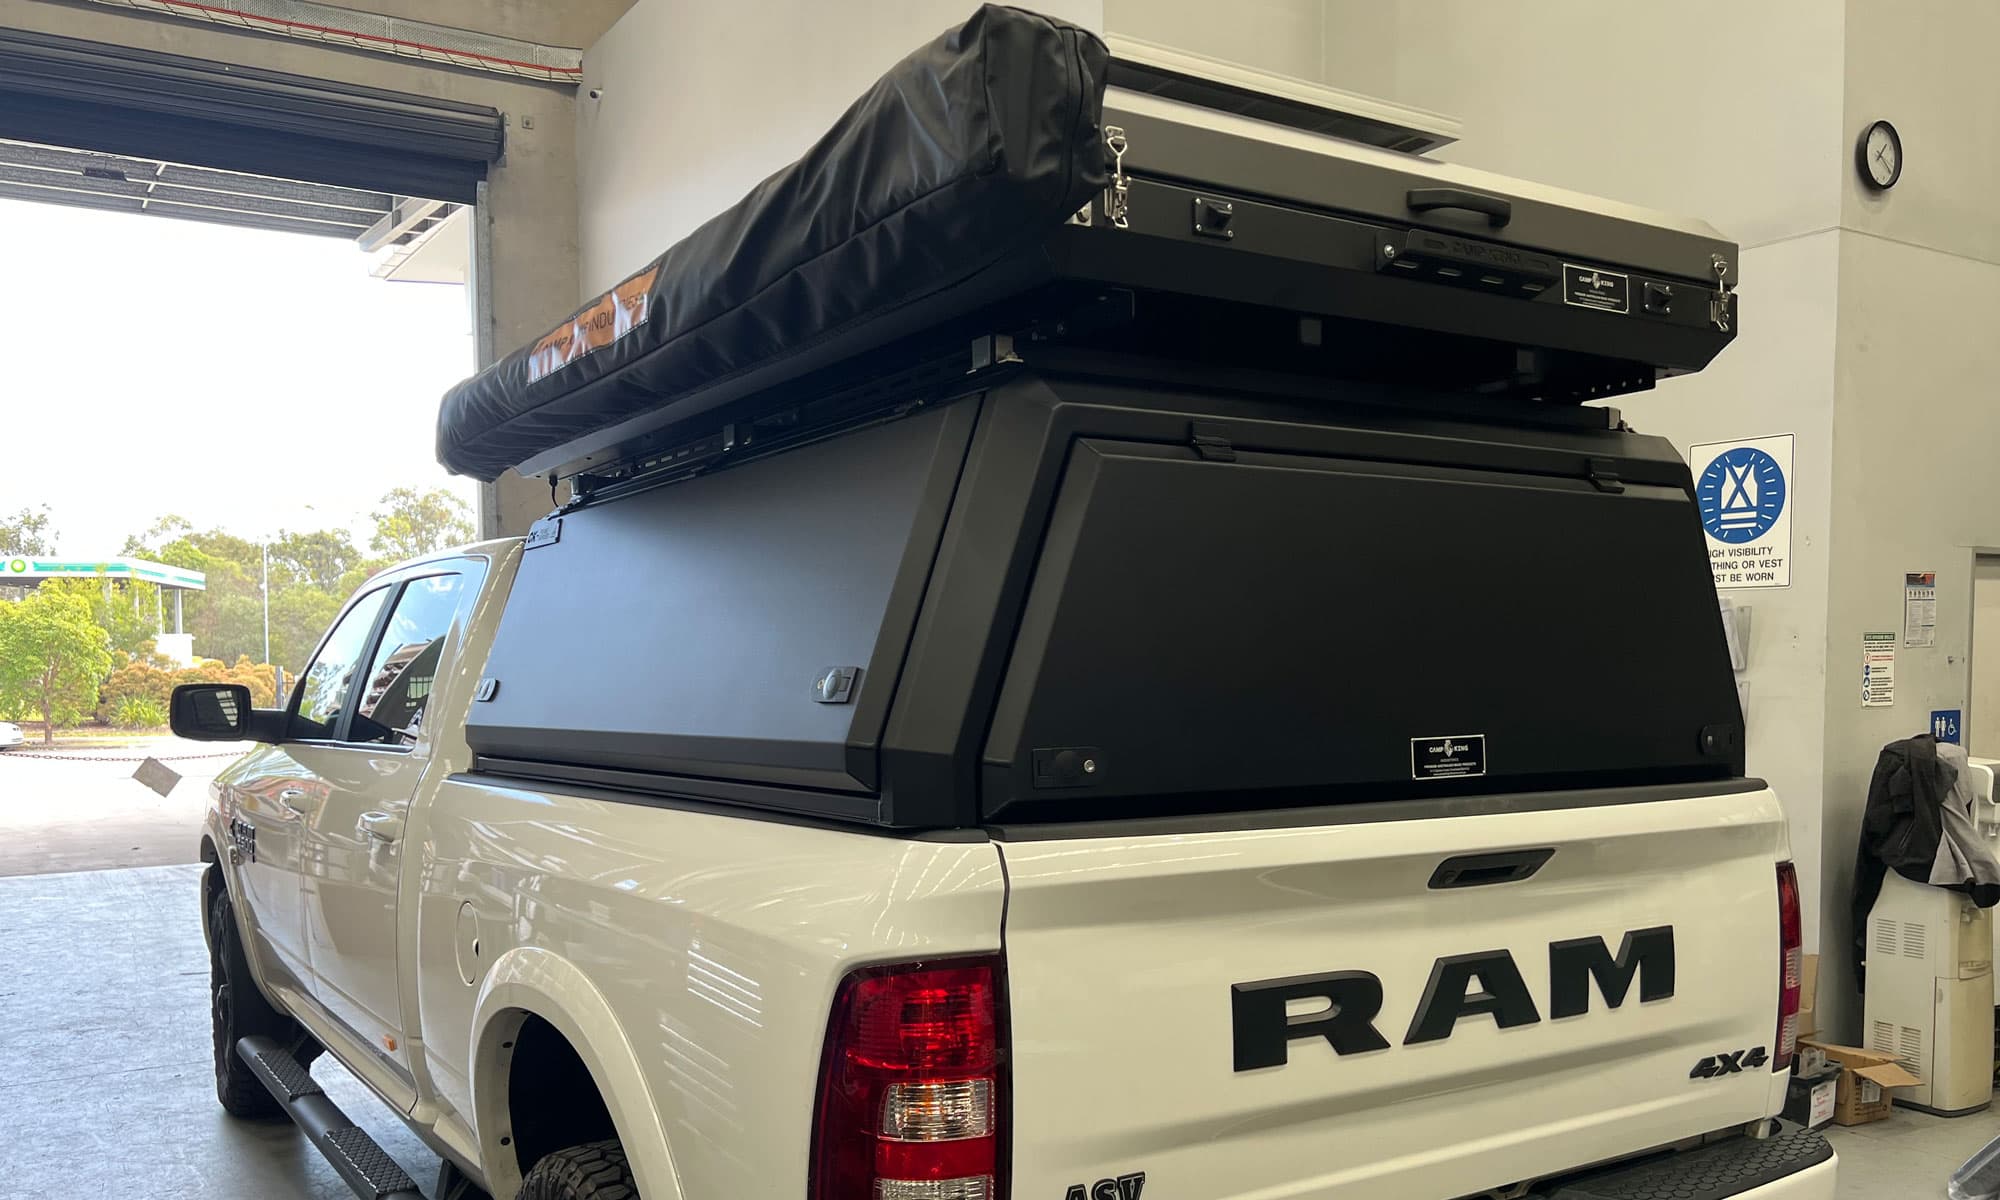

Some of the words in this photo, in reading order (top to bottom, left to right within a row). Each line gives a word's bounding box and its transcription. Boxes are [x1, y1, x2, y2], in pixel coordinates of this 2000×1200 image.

[1709, 549, 1725, 558] IGH
[1728, 546, 1773, 557] VISIBILITY
[1711, 561, 1738, 570] THING
[1741, 560, 1755, 569] OR
[1759, 558, 1783, 568] VEST
[1715, 574, 1726, 583] ST
[1730, 573, 1742, 582] BE
[1746, 572, 1774, 581] WORN
[1231, 924, 1675, 1073] RAM
